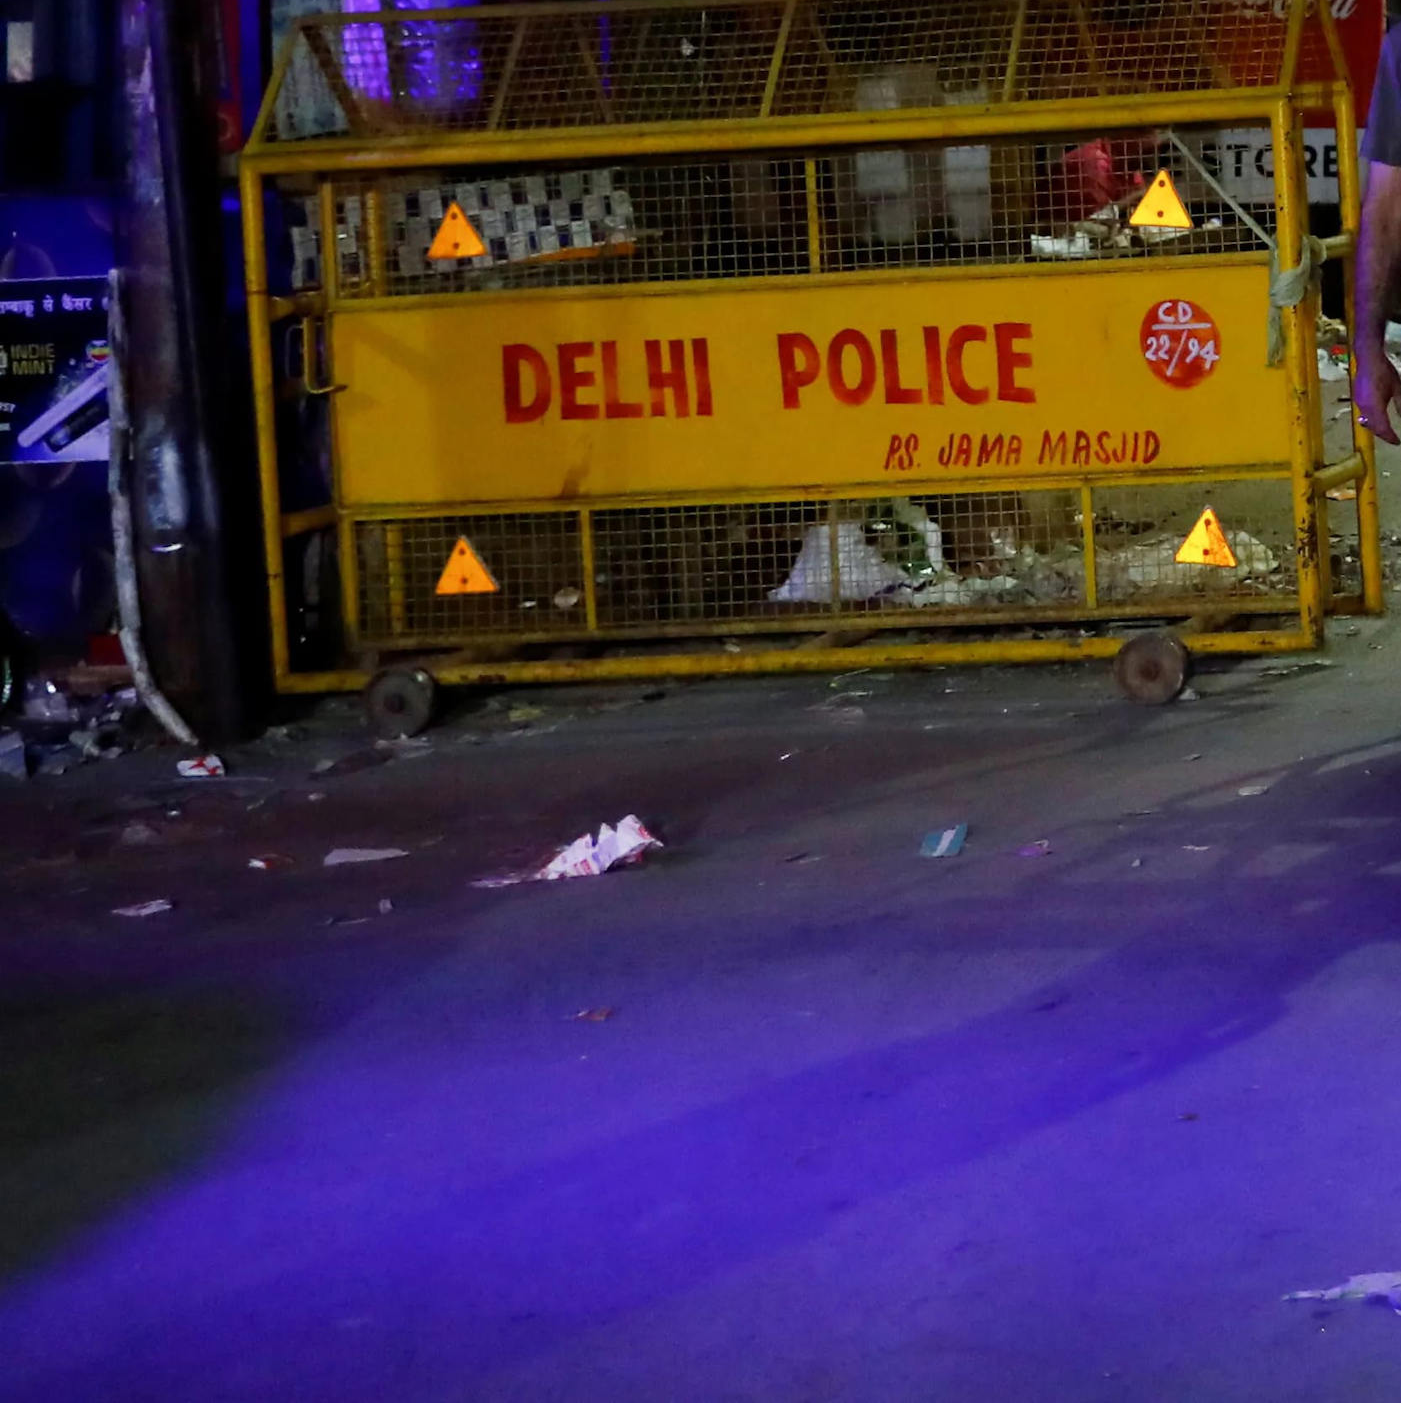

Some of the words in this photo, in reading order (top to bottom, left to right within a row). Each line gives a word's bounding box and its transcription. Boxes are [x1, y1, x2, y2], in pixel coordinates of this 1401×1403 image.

[1157, 300, 1193, 324] CD
[10, 343, 55, 360] INDIE
[12, 360, 55, 376] MINT
[501, 337, 714, 425] DELHI
[776, 321, 1038, 410] POLICE
[937, 432, 1022, 468] JAMA
[1037, 429, 1162, 466] MASJID
